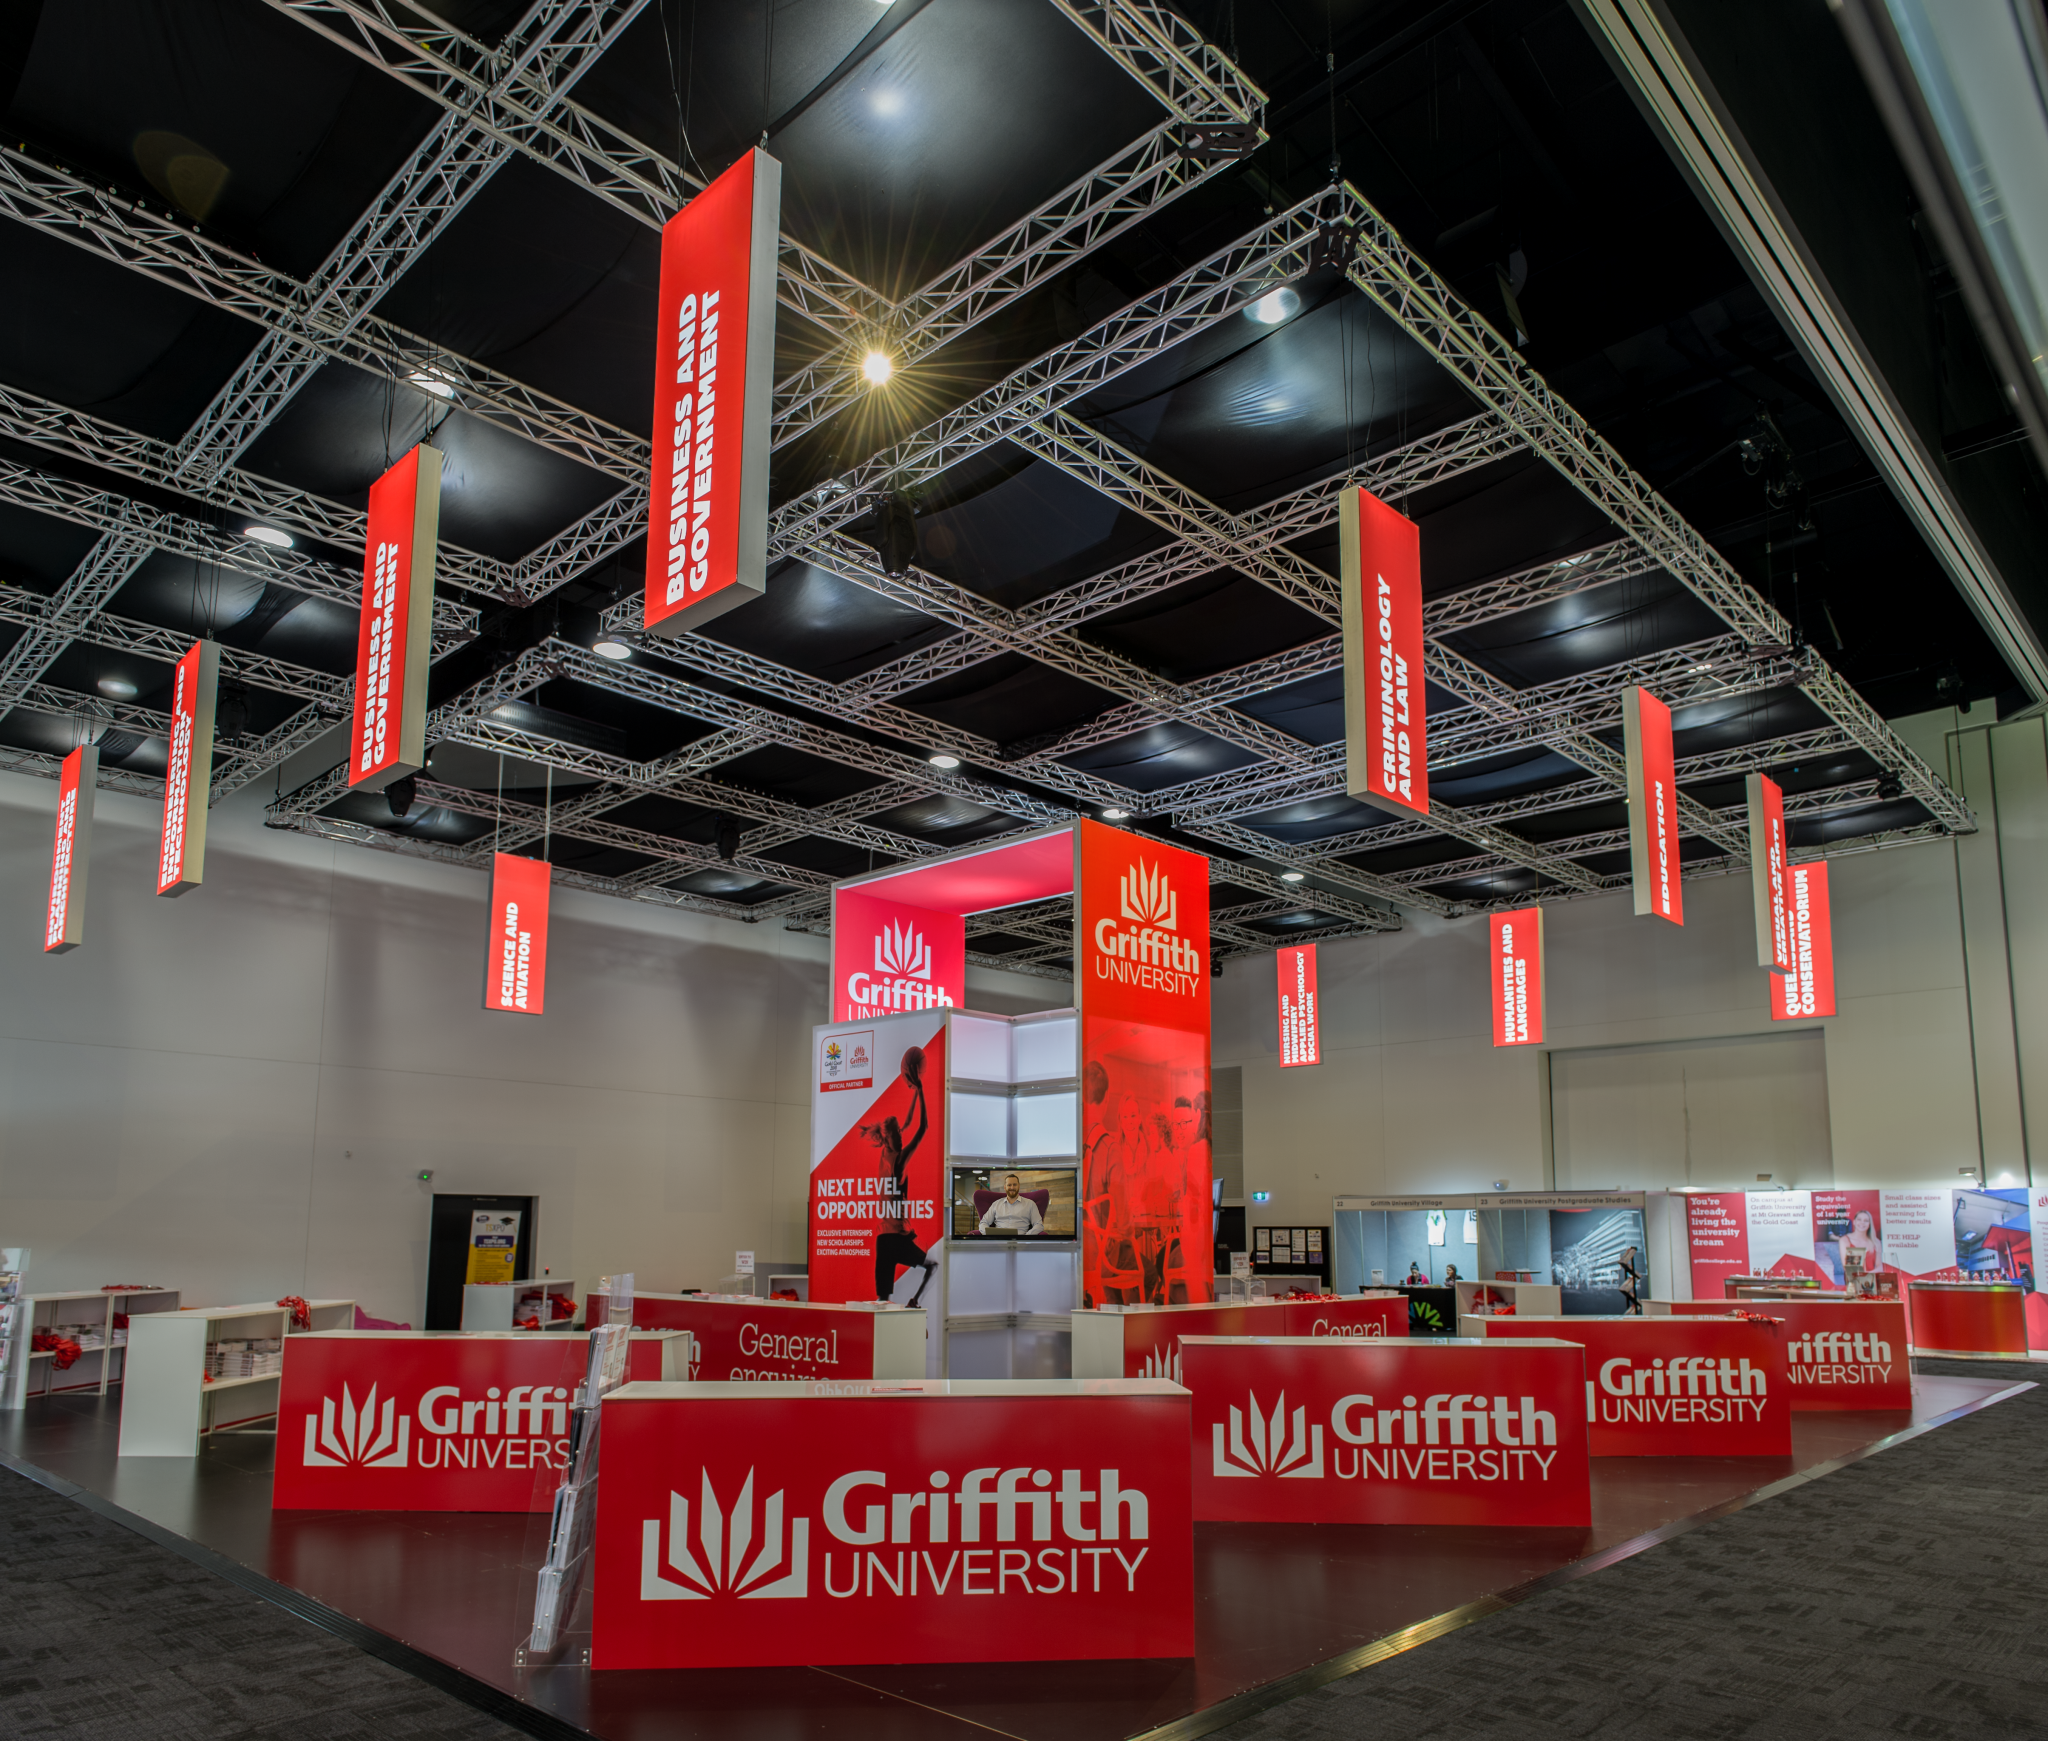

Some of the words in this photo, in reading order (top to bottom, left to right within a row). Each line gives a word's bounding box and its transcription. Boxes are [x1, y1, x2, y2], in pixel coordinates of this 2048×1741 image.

[677, 293, 697, 383] AND
[689, 289, 720, 593] GOVERNMENT
[666, 392, 693, 606] BUSINESS
[361, 615, 381, 772] BUSINESS
[372, 541, 386, 609] AND
[374, 542, 399, 765] GOVERNMENT
[1377, 573, 1396, 793] CRIMINOLOGY
[1395, 653, 1409, 726] LAW
[161, 725, 180, 888] ENGINEERING
[175, 665, 185, 716] AND
[1397, 730, 1412, 802] AND
[63, 791, 71, 835] AND
[167, 710, 187, 884] INFORMATION
[172, 715, 192, 881] TECHNOLOGY
[57, 787, 76, 941] ARCHITECTURE
[1655, 780, 1670, 915] EDUCATION
[1773, 818, 1782, 870] ARTS
[47, 799, 65, 947] ENVIRONMENT
[1770, 846, 1778, 890] AND
[505, 902, 518, 939] AND
[1502, 923, 1513, 954] AND
[1773, 893, 1782, 963] VISUAL
[1776, 872, 1787, 966] CREATIVE
[1095, 918, 1199, 975] Griffith
[1795, 870, 1815, 1015] CONSERVATORIUM
[501, 940, 516, 1007] SCIENCE
[515, 931, 531, 1010] AVIATION
[847, 971, 953, 1011] Griffith
[1096, 955, 1199, 997] UNIVERSITY
[1297, 951, 1306, 1017] PSYCHOLOGY
[1282, 994, 1290, 1017] AND
[1306, 991, 1314, 1025] WORK
[1503, 956, 1516, 1042] HUMANITIES
[1515, 959, 1528, 1042] LANGUAGES
[1283, 1018, 1291, 1064] NURSING
[1290, 1005, 1299, 1063] MIDWIFERY
[1299, 1019, 1307, 1062] APPLIED
[1307, 1025, 1316, 1062] SOCIAL
[850, 1056, 869, 1064] Griffith
[817, 1200, 934, 1219] OPPORTUNITIES
[818, 1178, 854, 1197] NEXT
[857, 1177, 901, 1195] LEVEL
[1524, 1198, 1556, 1206] University
[1557, 1197, 1604, 1205] Postgraduate
[1605, 1196, 1631, 1204] Studies
[1690, 1197, 1720, 1205] You're
[1815, 1195, 1834, 1203] Study
[842, 1229, 872, 1237] INTERNSHIPS
[1691, 1208, 1727, 1217] already
[1691, 1218, 1719, 1227] living
[1720, 1218, 1736, 1226] the
[1692, 1228, 1740, 1238] university
[1693, 1238, 1724, 1246] dream
[739, 1322, 839, 1364] General
[1312, 1313, 1387, 1338] General
[1787, 1331, 1892, 1363] riffith
[1600, 1357, 1768, 1396] Griffith
[1786, 1364, 1893, 1384] NIVERSITY
[418, 1386, 585, 1435] Griffi
[1331, 1394, 1557, 1446] Griffith
[1602, 1398, 1768, 1423] UNIVERSITY
[417, 1438, 571, 1469] UNIVERS
[1333, 1448, 1558, 1481] UNIVERSITY
[822, 1467, 1150, 1545] Griffith
[824, 1547, 1150, 1598] UNIVERSITY
